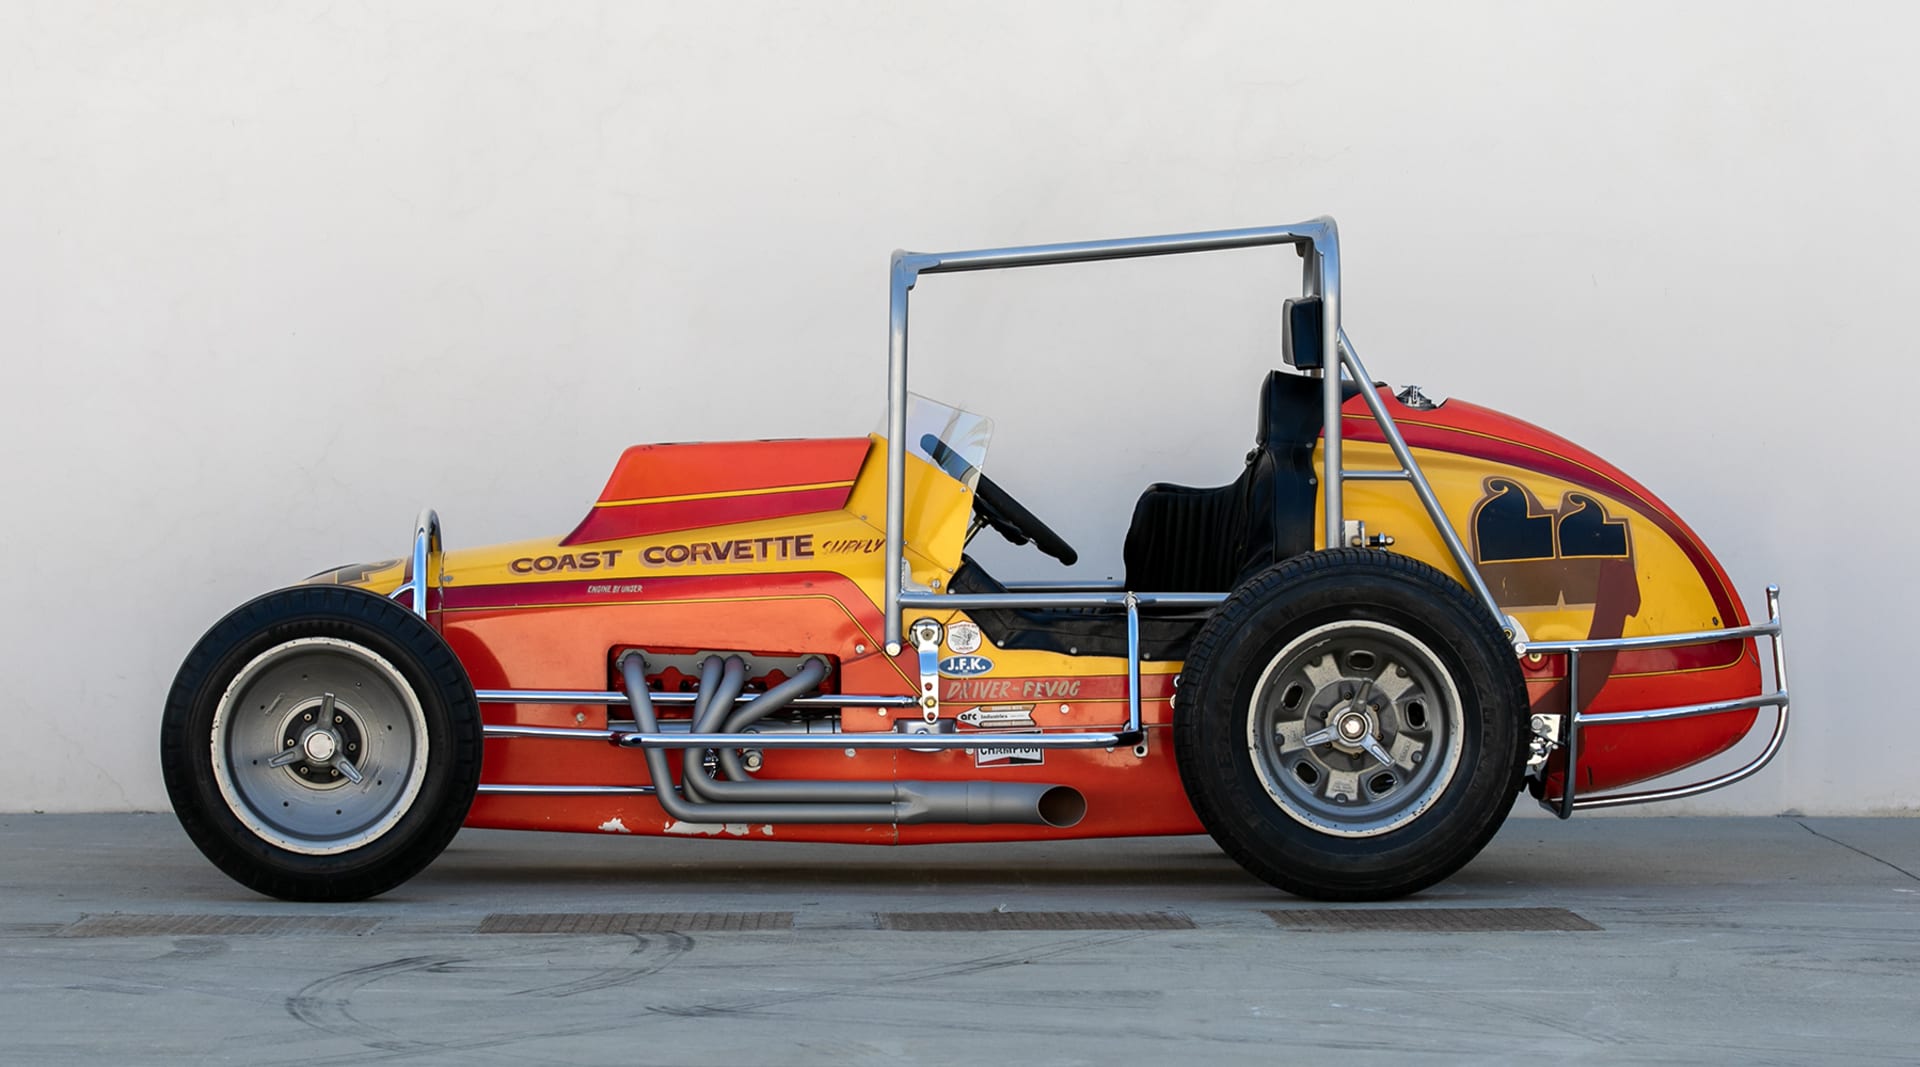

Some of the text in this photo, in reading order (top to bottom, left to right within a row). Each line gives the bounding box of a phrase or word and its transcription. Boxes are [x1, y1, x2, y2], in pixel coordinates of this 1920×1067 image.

[510, 549, 623, 575] COAST
[641, 533, 815, 567] CORVETTE
[947, 658, 986, 671] J.F.K.
[960, 713, 977, 721] arc
